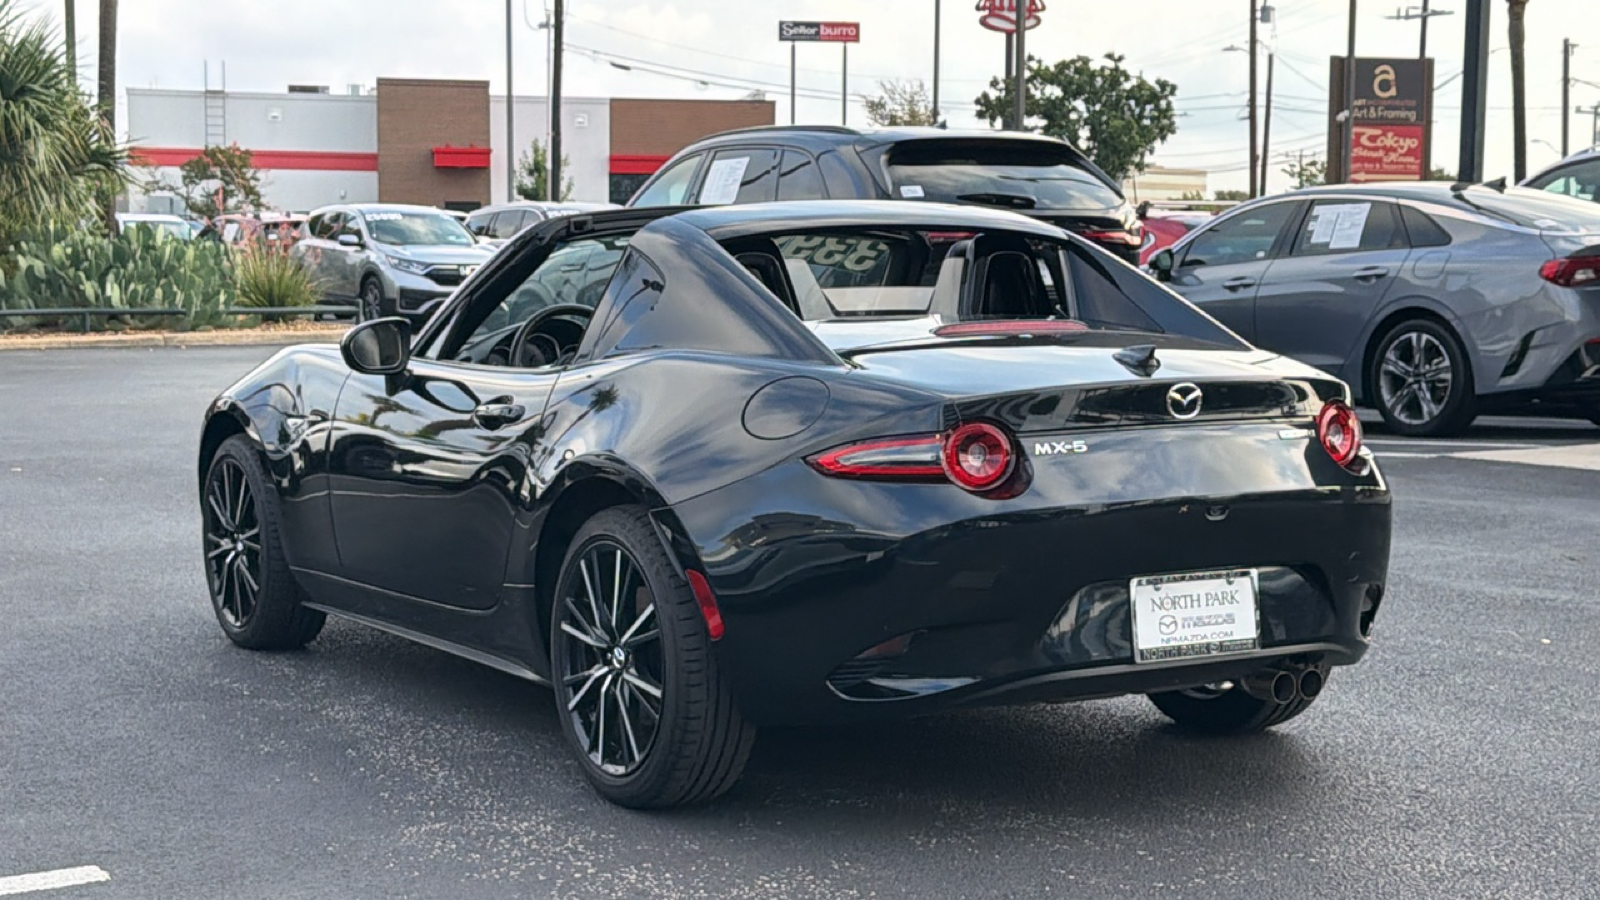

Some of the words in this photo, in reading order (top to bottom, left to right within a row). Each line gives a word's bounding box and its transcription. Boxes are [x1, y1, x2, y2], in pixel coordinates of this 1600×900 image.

[820, 24, 857, 36] burro
[1352, 107, 1367, 119] Art
[1369, 106, 1376, 118] &
[1378, 106, 1417, 122] Framing
[1351, 126, 1419, 154] Tokyo
[1034, 440, 1088, 455] MX-5
[1151, 592, 1201, 612] NORTH
[1205, 590, 1240, 607] PARK
